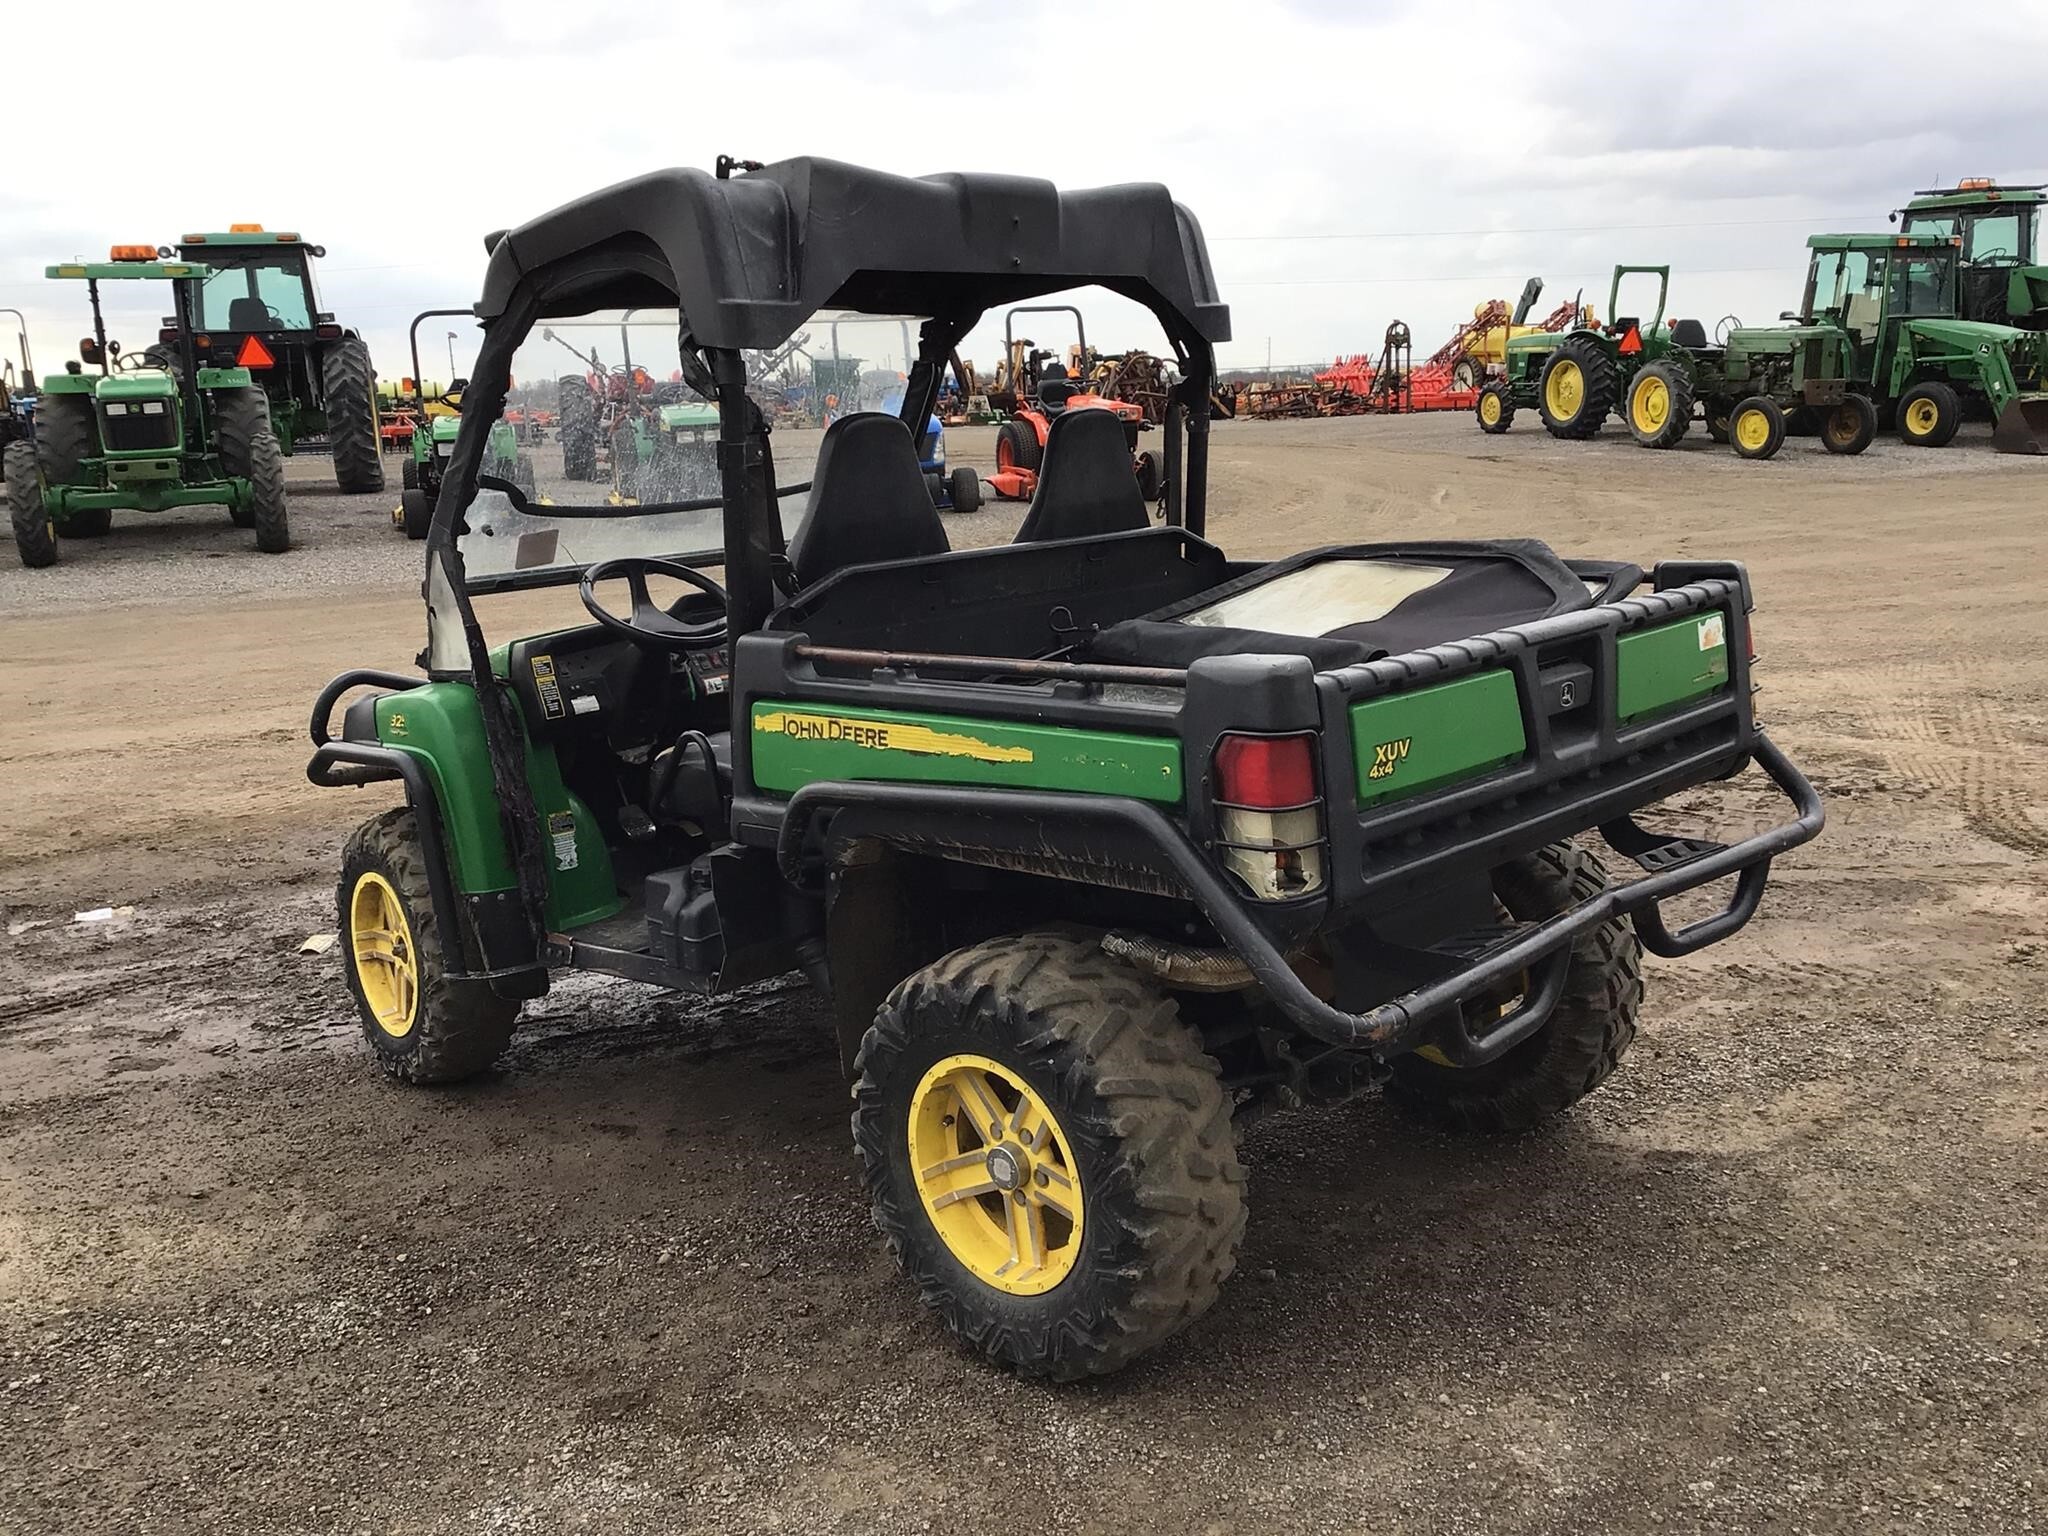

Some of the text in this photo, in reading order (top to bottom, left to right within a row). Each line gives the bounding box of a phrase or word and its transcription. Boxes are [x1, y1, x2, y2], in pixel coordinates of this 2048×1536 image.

[782, 715, 889, 747] JOHN DEERE
[1375, 738, 1410, 765] XUV
